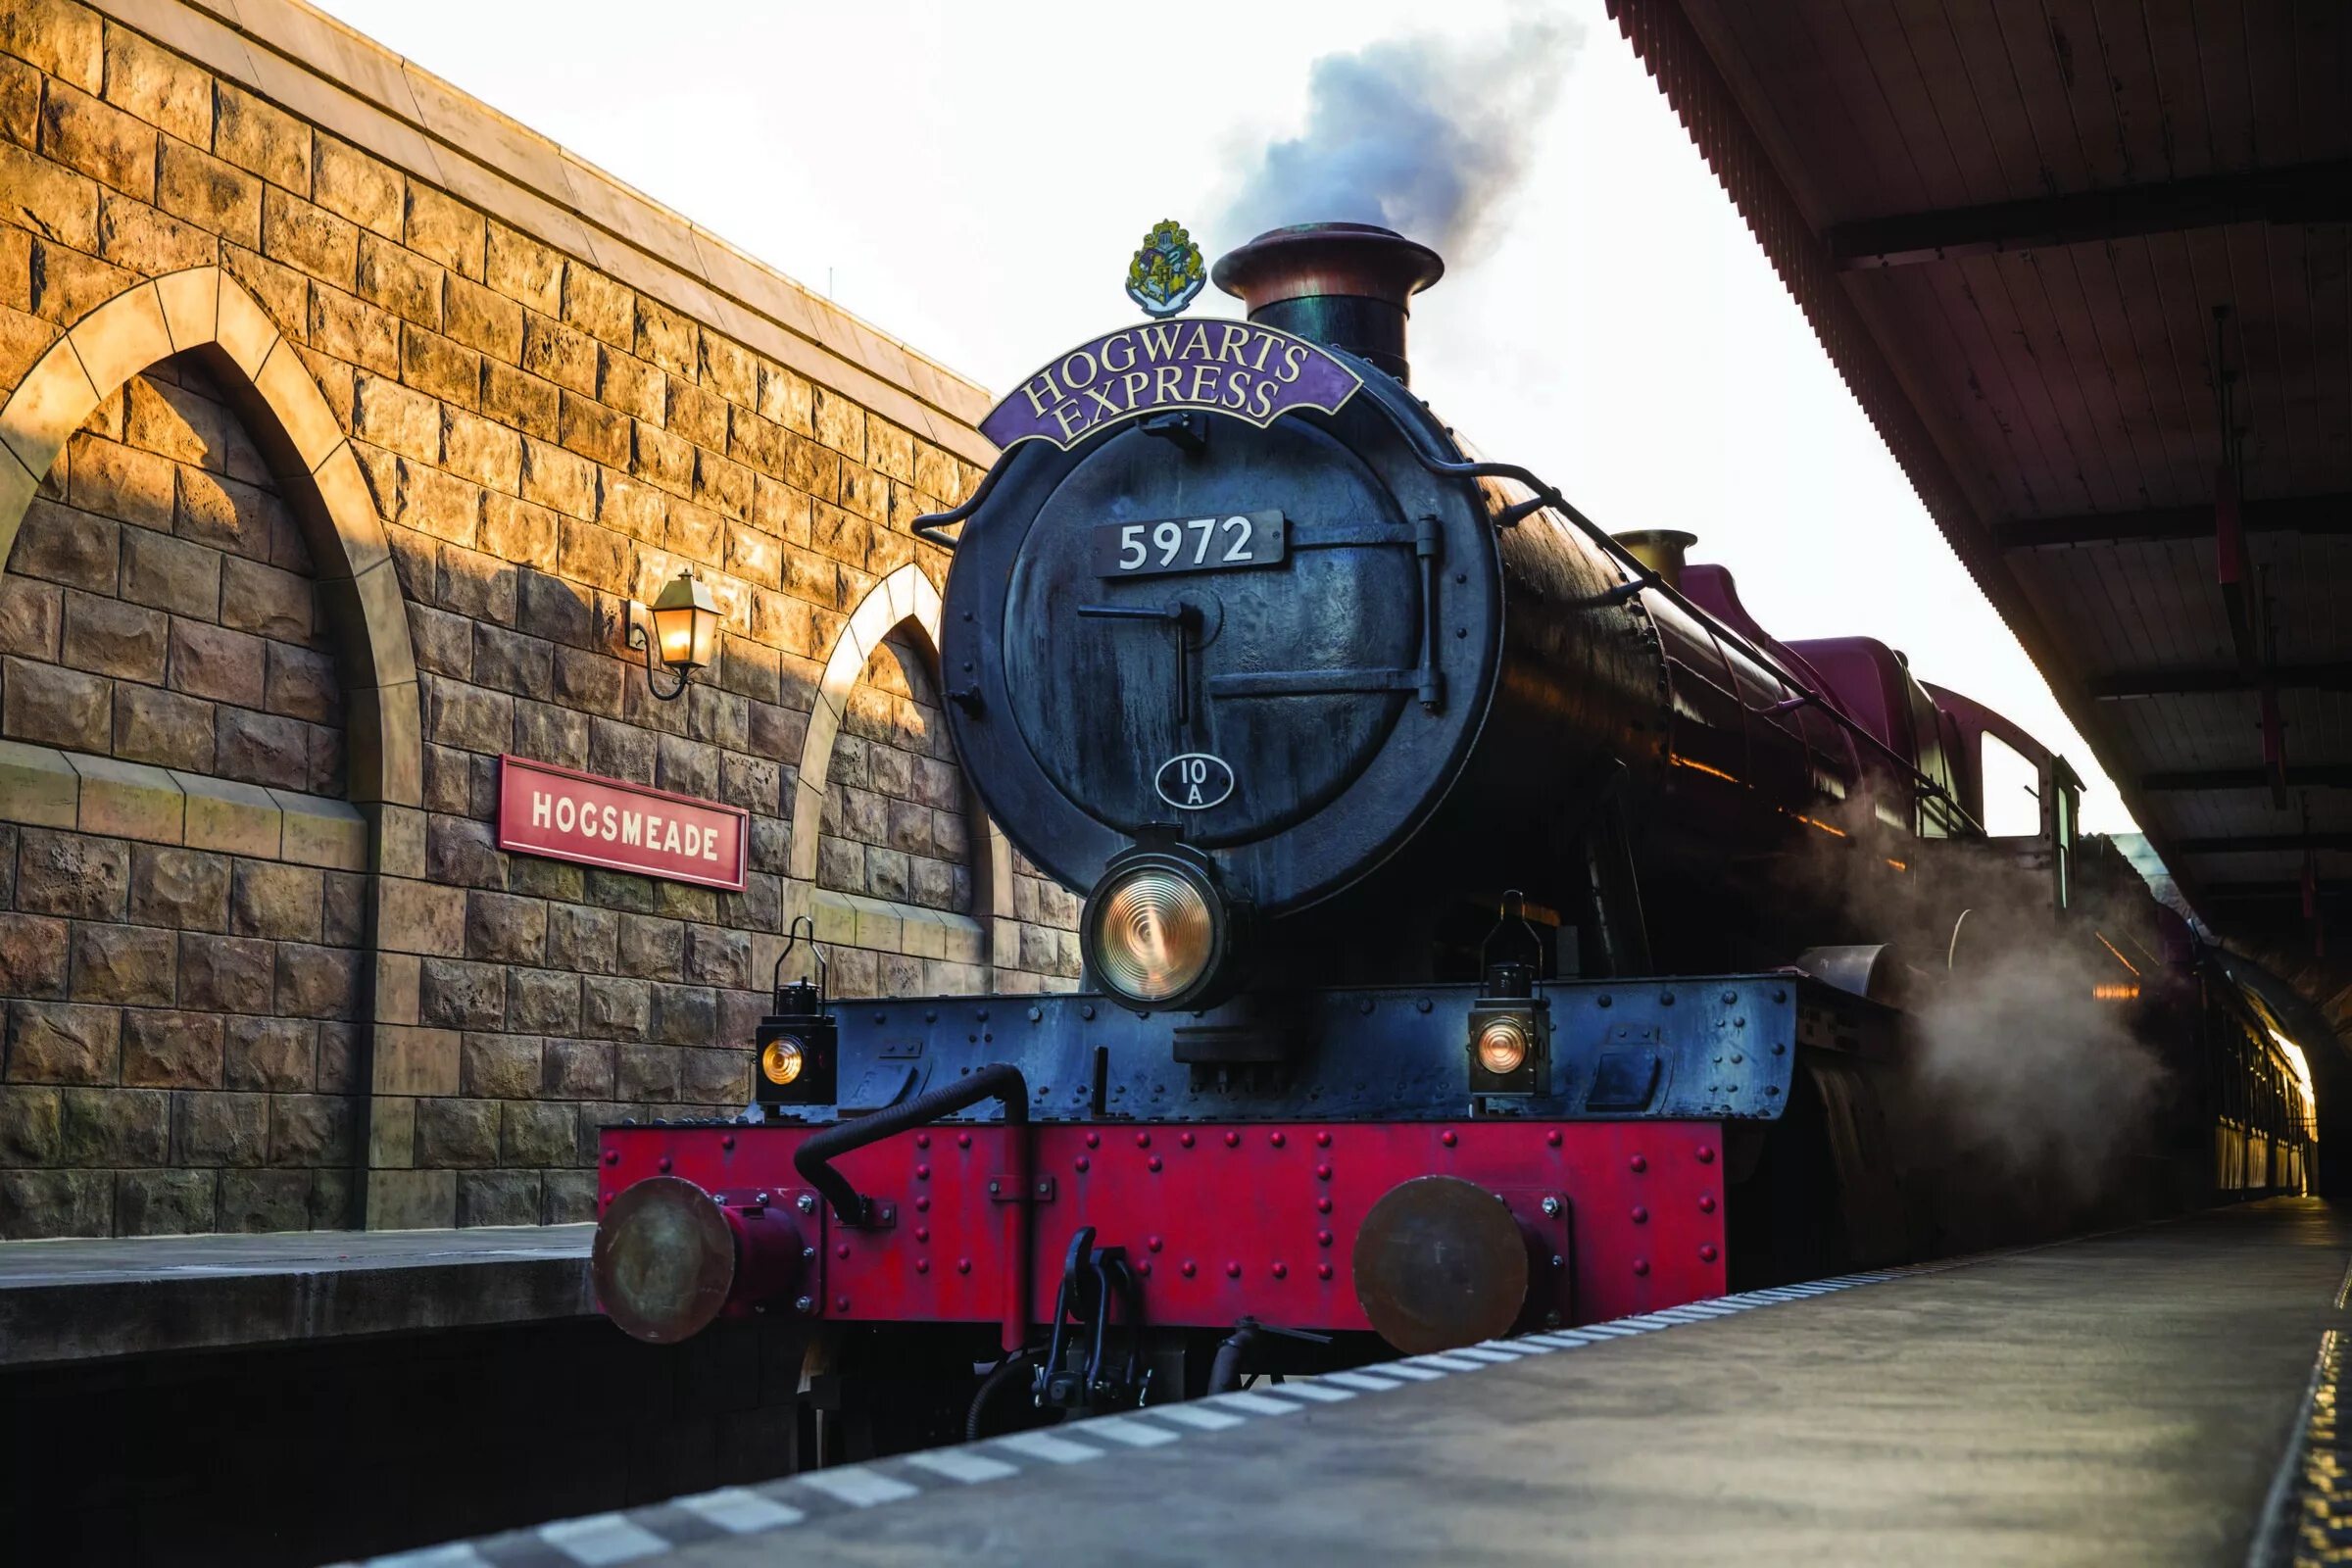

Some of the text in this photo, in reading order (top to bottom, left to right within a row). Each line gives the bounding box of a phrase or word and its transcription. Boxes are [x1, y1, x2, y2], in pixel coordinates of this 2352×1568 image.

[1021, 324, 1307, 419] HOGWARTS
[1052, 367, 1280, 443] EXPRESS
[1119, 515, 1252, 570] 5972
[1182, 759, 1206, 783] 10
[1188, 784, 1203, 804] A
[532, 791, 718, 861] HOGSMEADE
